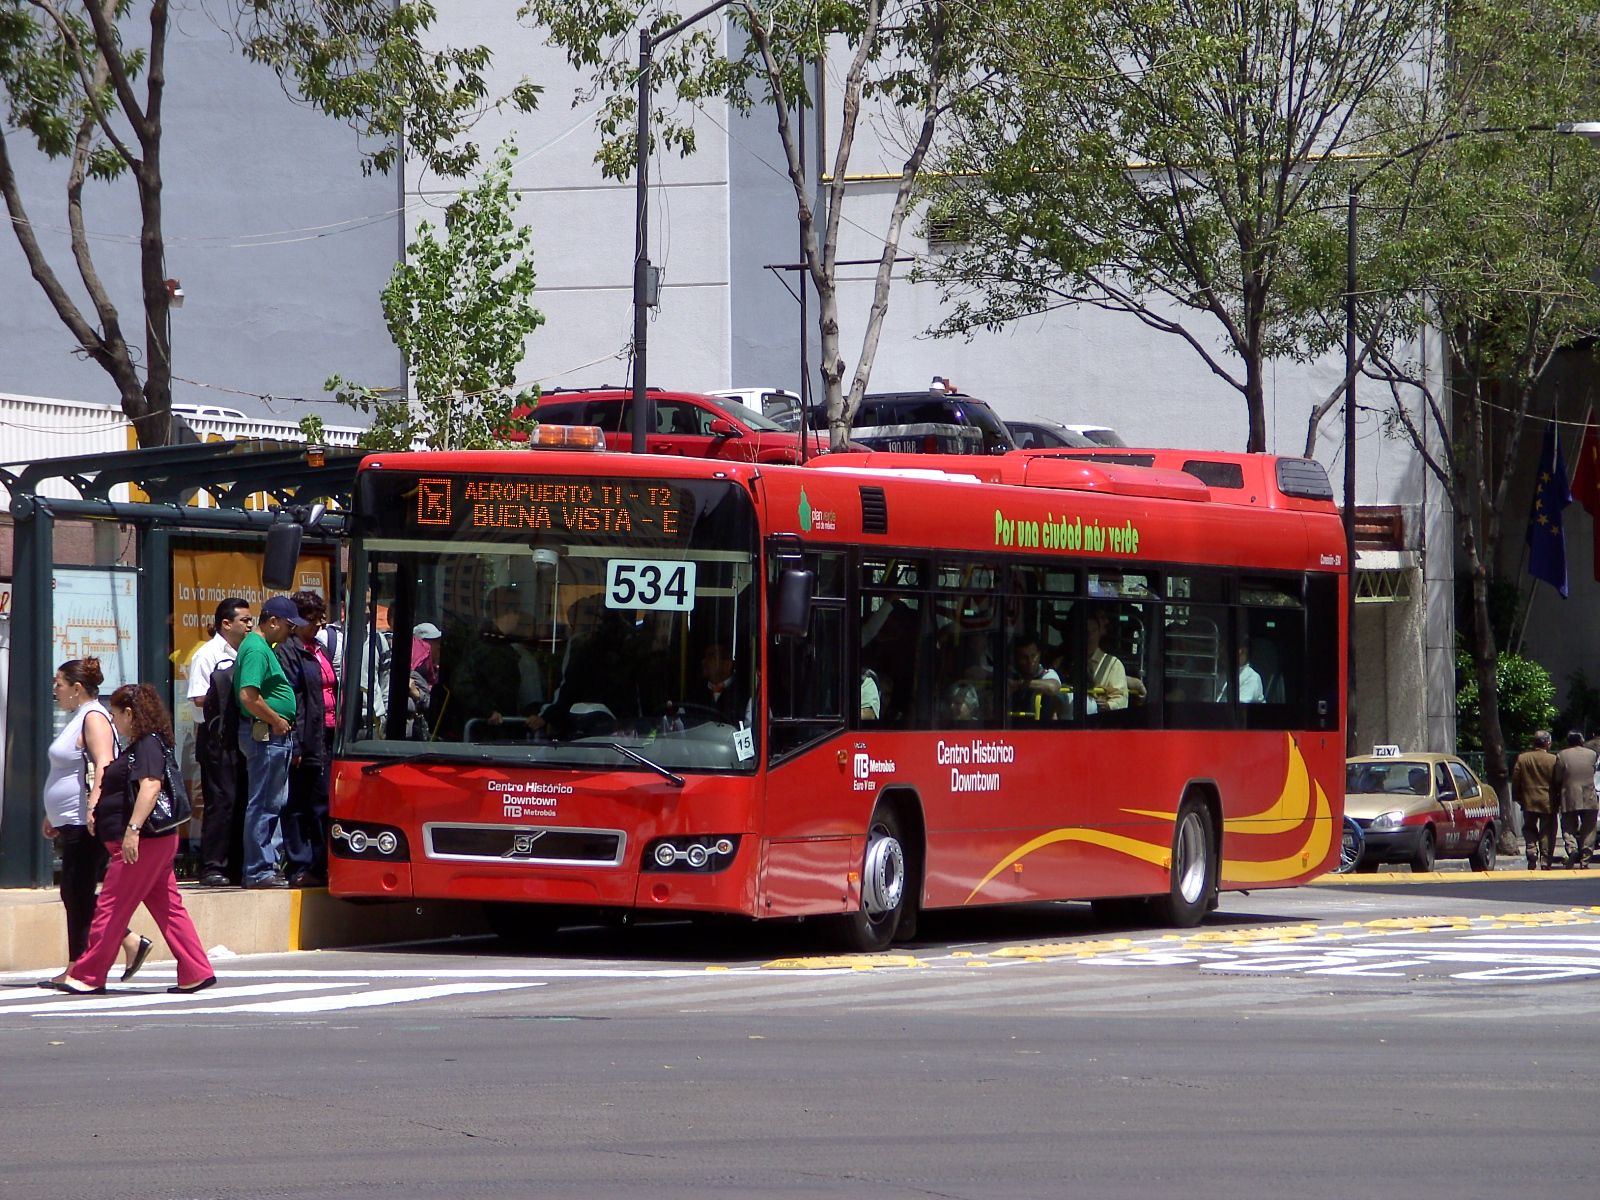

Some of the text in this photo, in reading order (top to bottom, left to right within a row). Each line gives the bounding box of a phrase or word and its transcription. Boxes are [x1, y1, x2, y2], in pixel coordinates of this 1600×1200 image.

[465, 482, 594, 503] AEROPUERTO
[601, 486, 621, 504] T1
[648, 488, 671, 506] T2
[473, 504, 552, 529] BUENA
[562, 506, 631, 532] VISTA
[663, 510, 679, 533] E
[994, 509, 1139, 554] Por una ciudad más verde
[178, 583, 190, 600] La
[207, 583, 226, 600] más
[612, 565, 688, 606] 534
[182, 613, 199, 627] con
[737, 736, 751, 751] 15
[1376, 747, 1396, 756] TAXI
[937, 739, 1014, 765] Centro Histórico
[869, 759, 896, 773] Metrobús
[488, 781, 573, 794] Centro Histórico
[951, 768, 1000, 792] Downtown
[503, 794, 557, 806] Downtown
[523, 808, 556, 817] Metrobús
